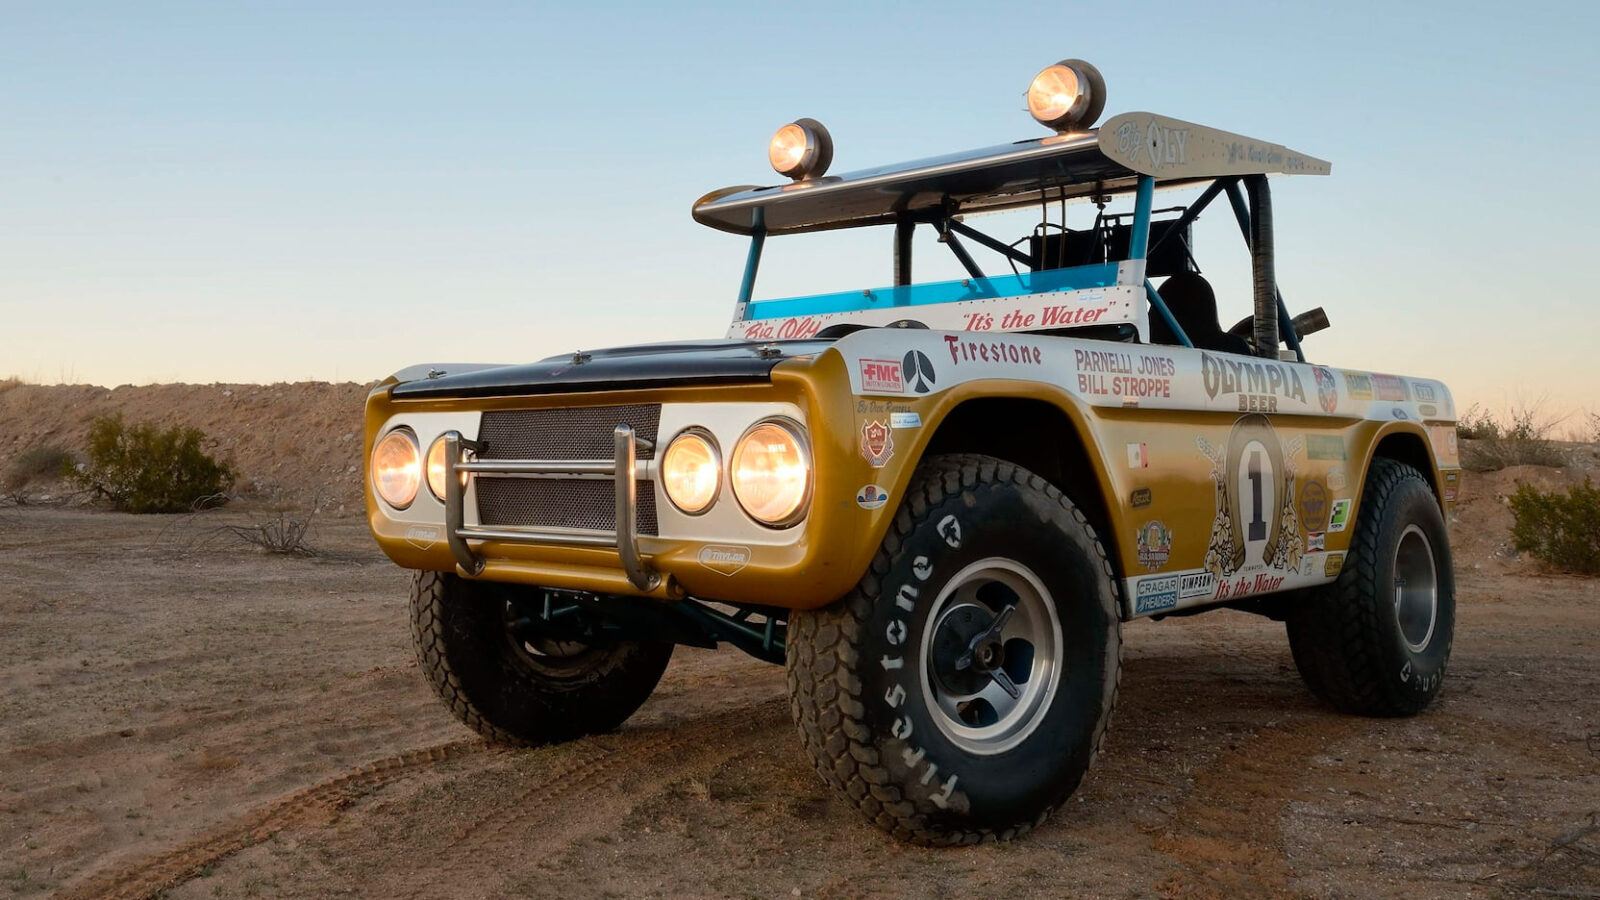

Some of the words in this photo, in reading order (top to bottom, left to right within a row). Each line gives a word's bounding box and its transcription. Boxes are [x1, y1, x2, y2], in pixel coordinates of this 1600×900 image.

[1117, 120, 1140, 162] Big
[1001, 309, 1036, 329] the
[944, 335, 1041, 365] Firestone
[864, 363, 900, 383] FMC
[1074, 349, 1132, 374] PARNELLI
[1138, 355, 1175, 376] JONES
[1078, 374, 1108, 395] BILL
[1112, 377, 1170, 398] STROPPE
[1201, 351, 1307, 404] OLYMPIA
[1238, 394, 1277, 412] BEER
[1248, 451, 1266, 541] 1
[1138, 579, 1176, 595] CRAGAR
[1182, 574, 1211, 590] SIMPSON
[1213, 579, 1230, 600] It's
[1233, 576, 1250, 596] the
[1253, 573, 1285, 593] Water
[1145, 594, 1175, 609] HEADERS
